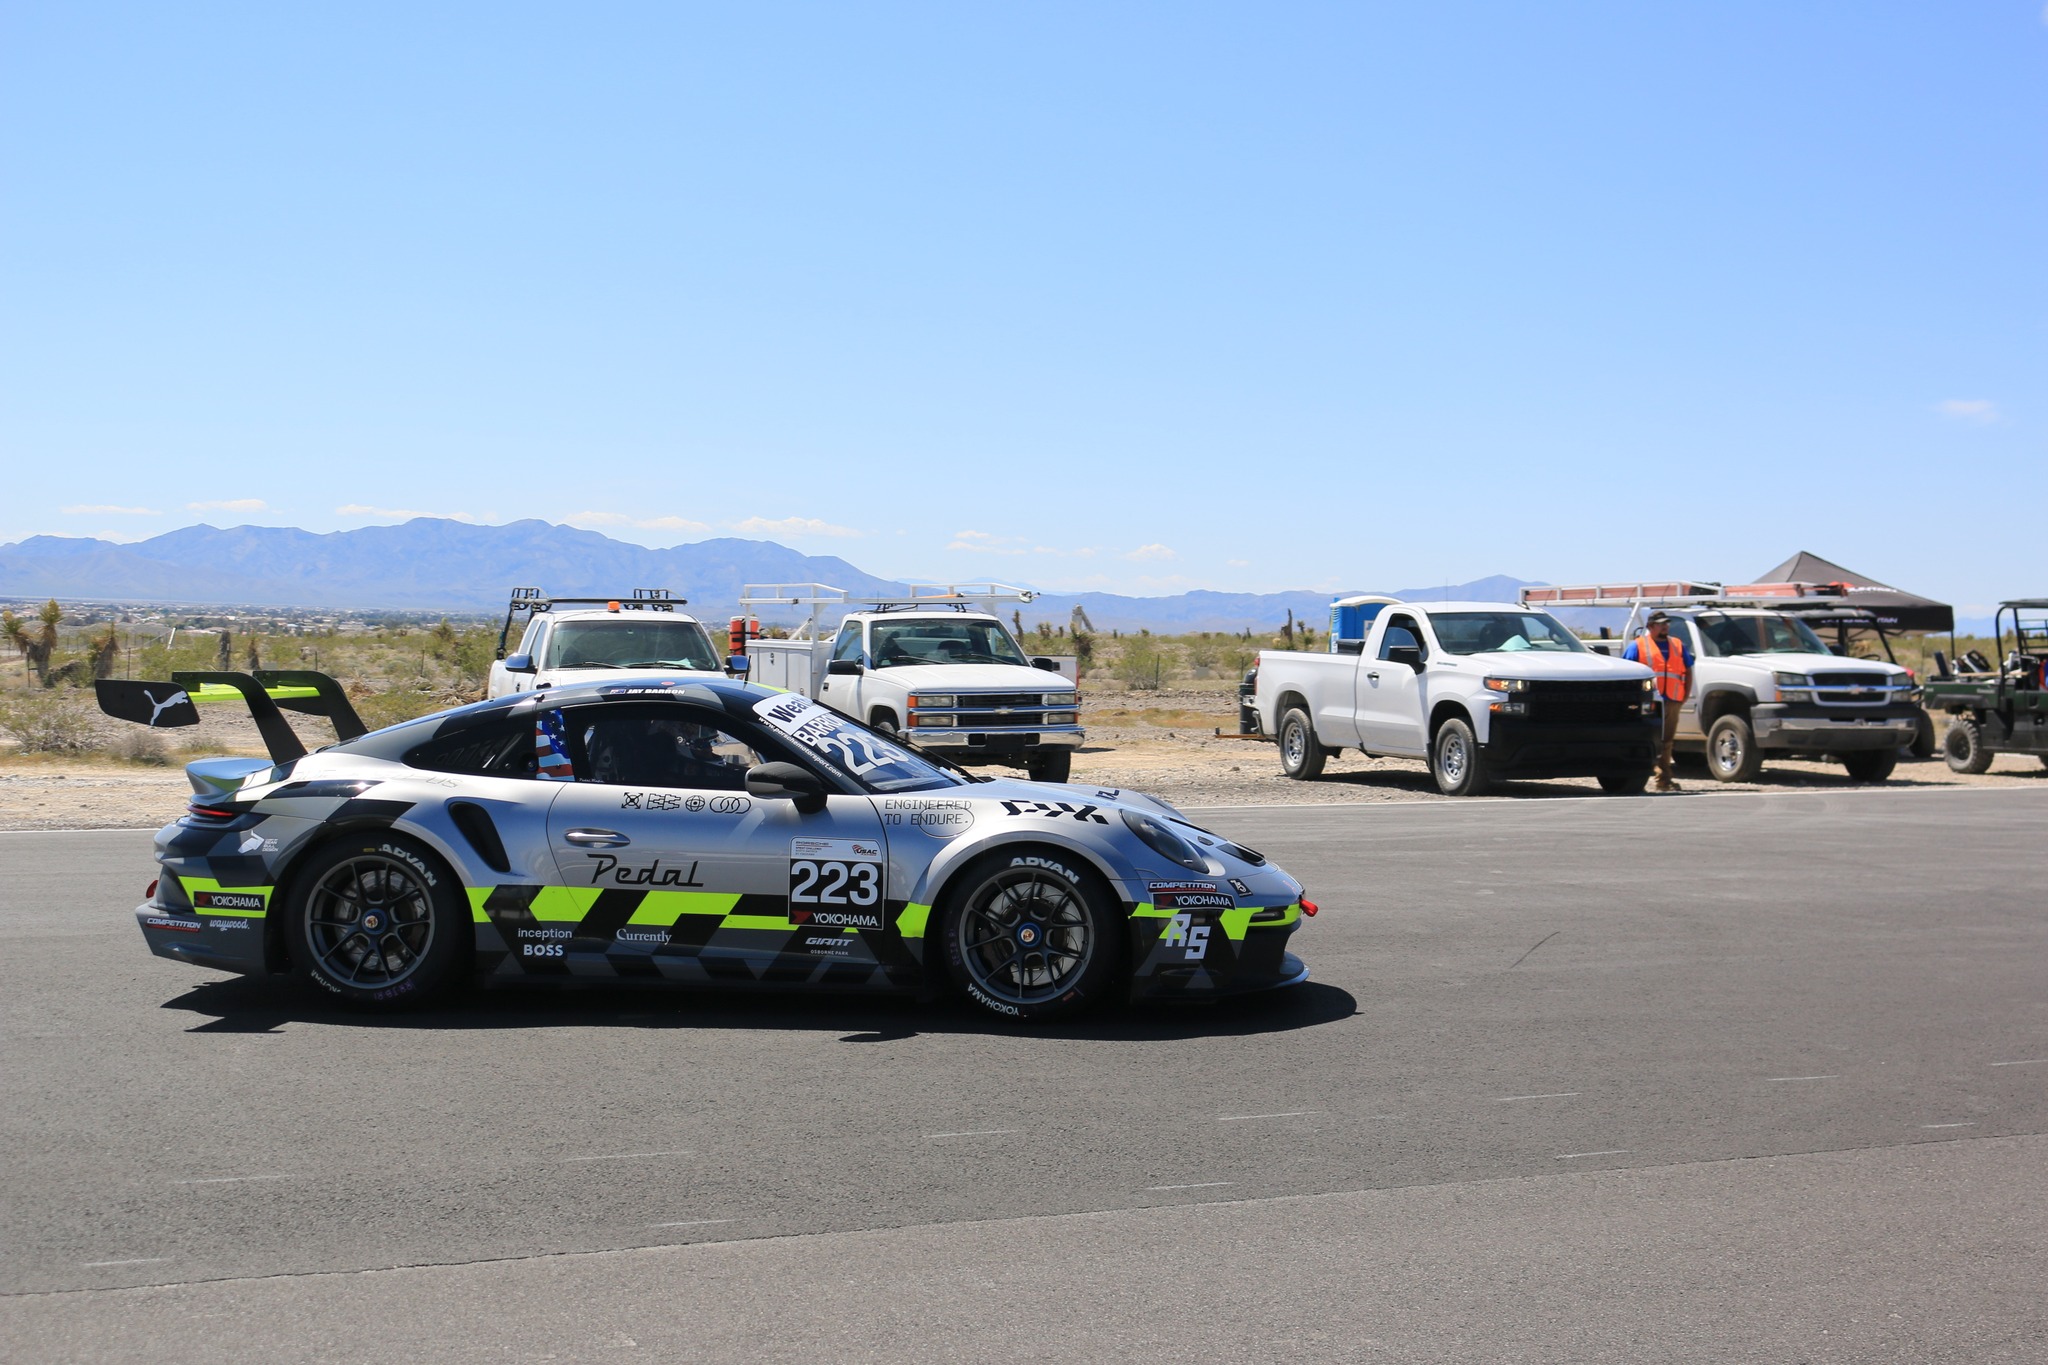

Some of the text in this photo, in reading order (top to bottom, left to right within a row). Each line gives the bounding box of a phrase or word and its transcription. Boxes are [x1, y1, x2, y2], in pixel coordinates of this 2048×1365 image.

[758, 716, 843, 778] www.porschemotorsport.com
[816, 732, 910, 776] 223
[885, 799, 972, 810] ENGINEERED
[885, 813, 970, 826] TO ENDURE.
[379, 843, 438, 887] ADVAN
[586, 853, 705, 888] Pedal
[1009, 856, 1080, 884] ADVAN
[790, 860, 879, 906] 223
[1149, 881, 1216, 889] COMPETITION
[210, 895, 261, 908] YOKOHAMA
[1175, 895, 1232, 907] YOKOHAMA
[147, 918, 202, 929] COMPETITION
[812, 912, 878, 926] YOKOHAMA
[517, 927, 573, 941] inception
[616, 927, 673, 945] Currently
[805, 937, 855, 947] GIANT
[523, 944, 564, 957] BOSS
[967, 982, 1020, 1016] YOKOHAMA
